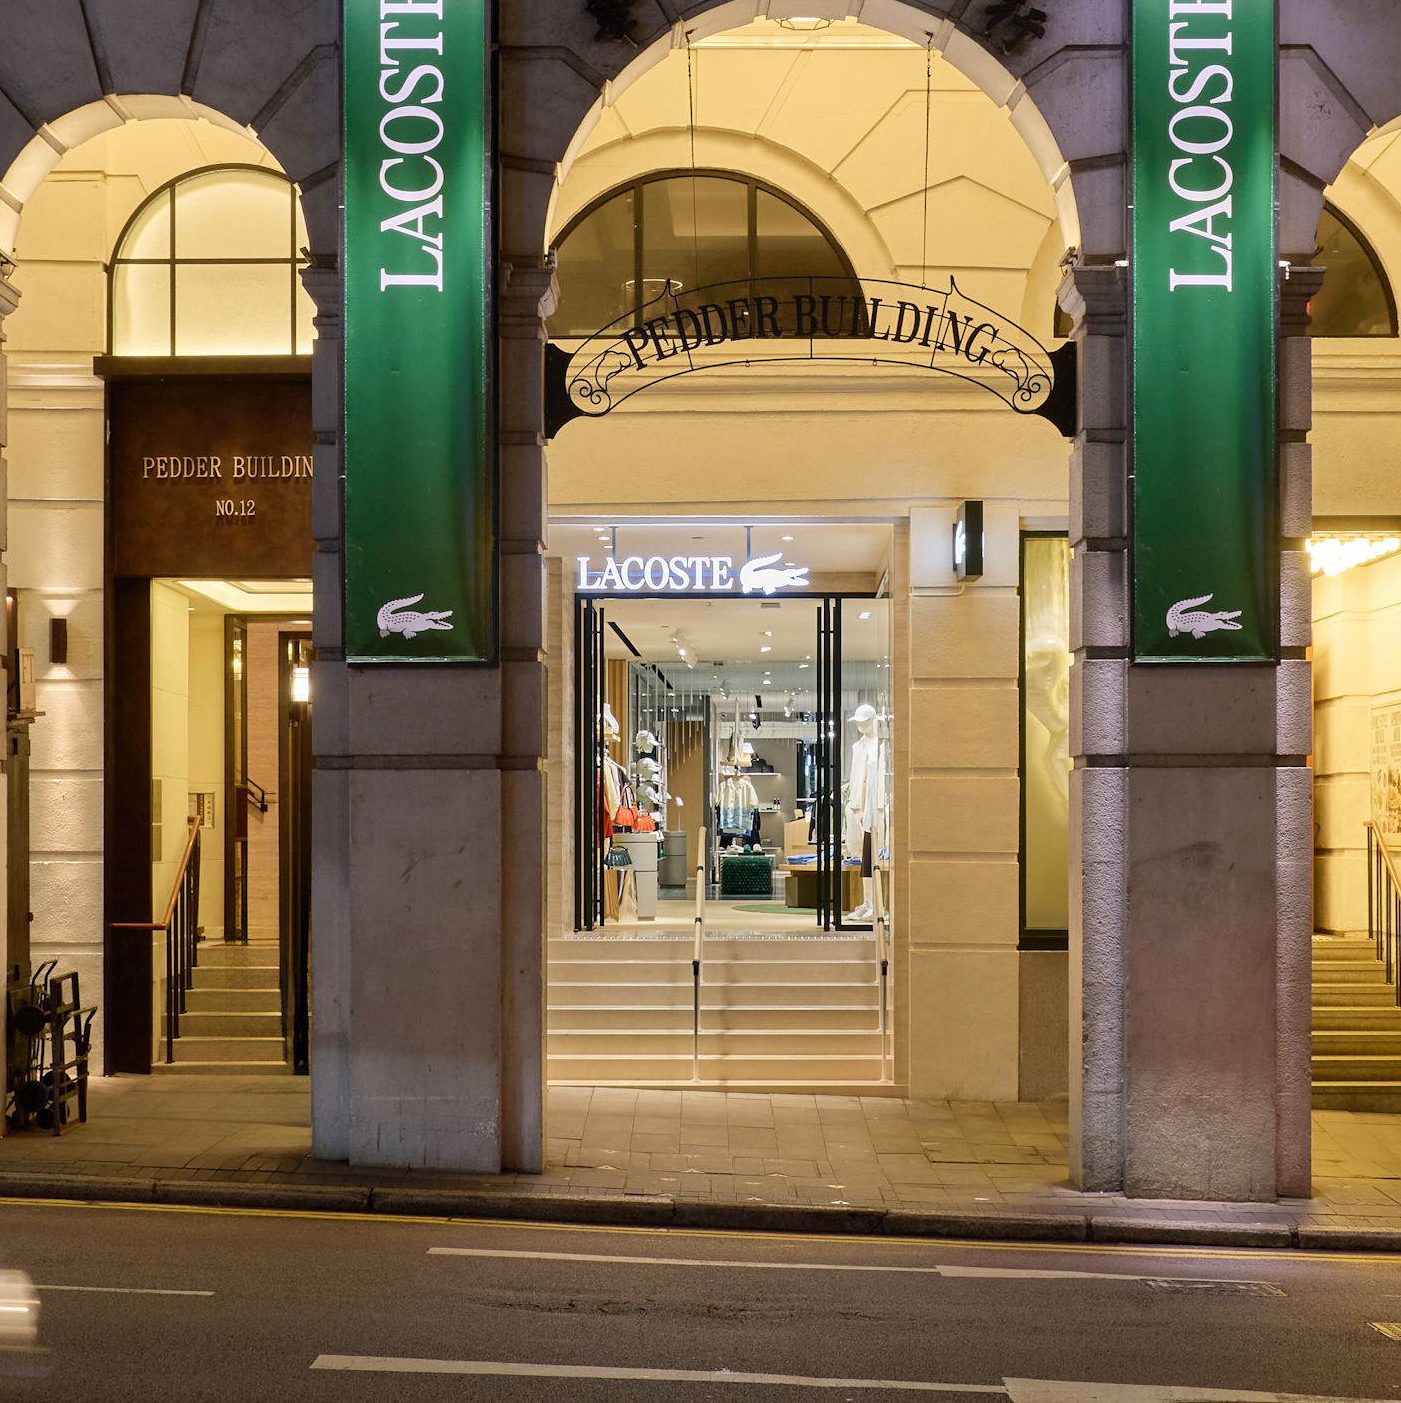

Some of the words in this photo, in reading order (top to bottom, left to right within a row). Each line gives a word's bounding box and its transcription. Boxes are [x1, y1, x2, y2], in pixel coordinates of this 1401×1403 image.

[620, 296, 783, 371] PEDDER
[793, 295, 1001, 367] BUILDING
[142, 456, 222, 478] PEDDER
[215, 499, 255, 517] NO.12
[576, 555, 734, 591] LACOSTE
